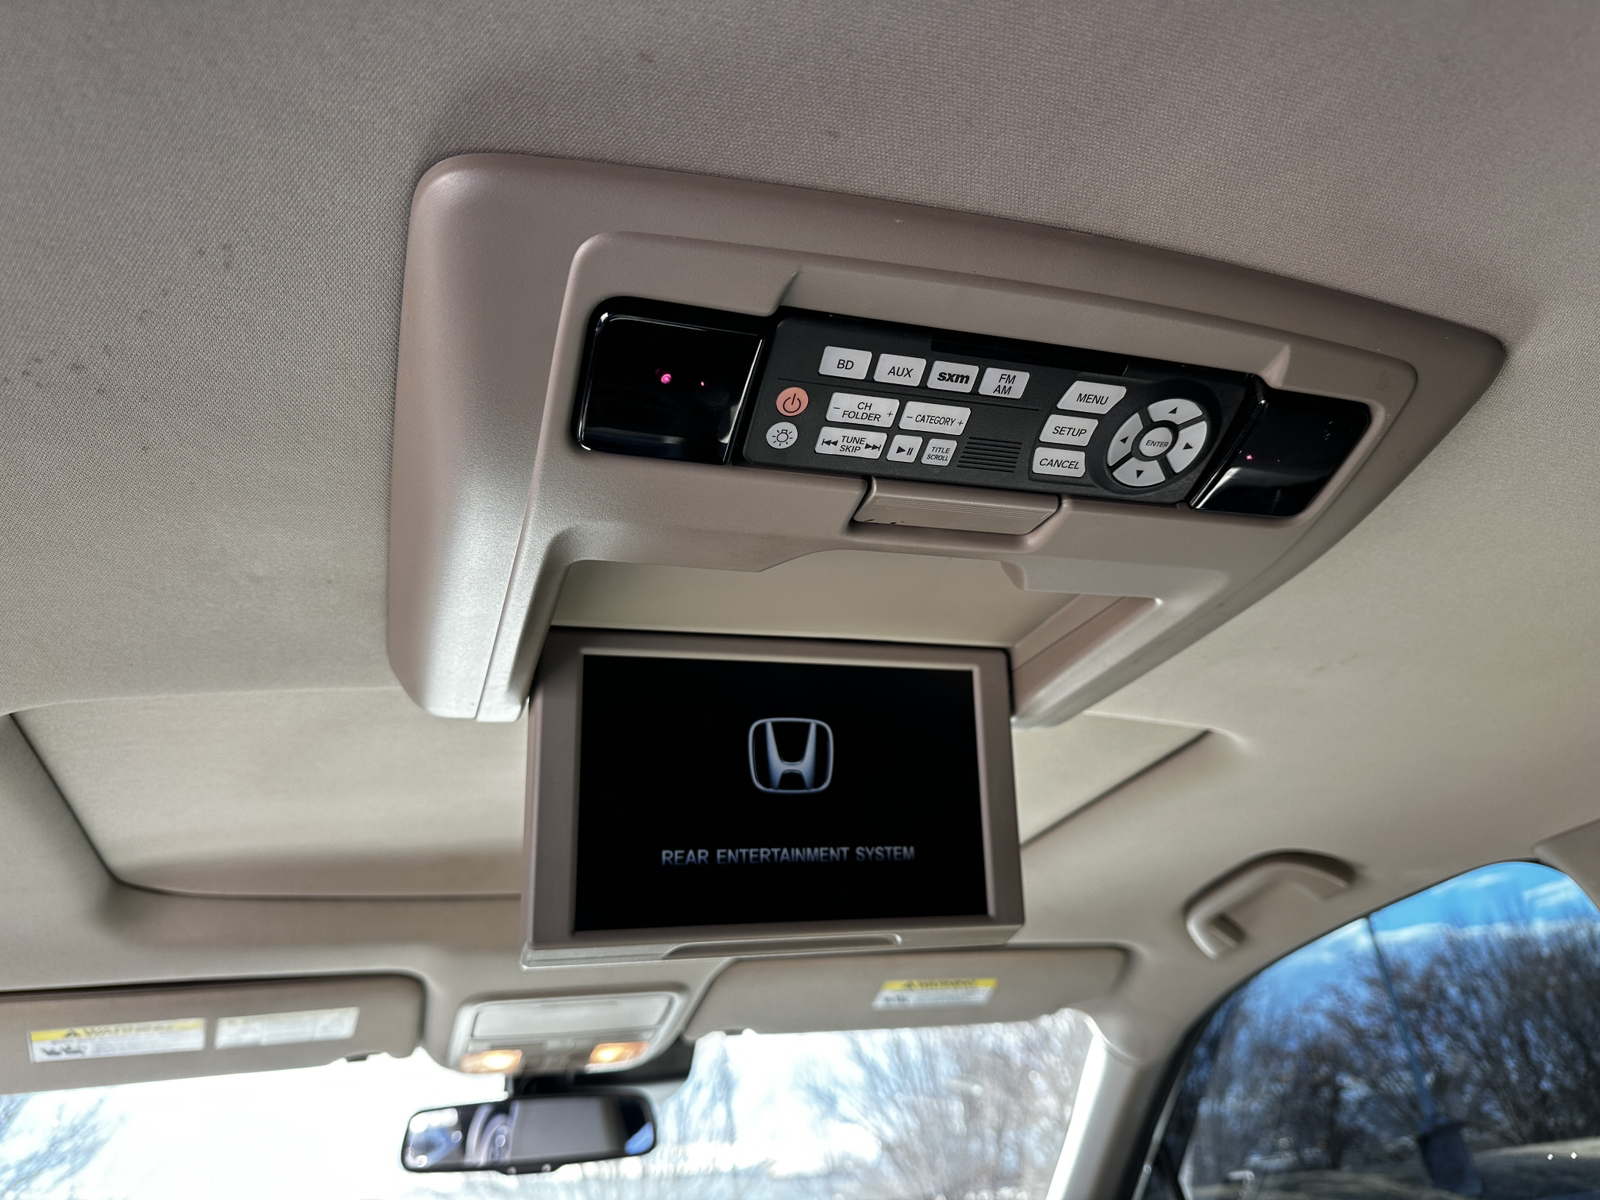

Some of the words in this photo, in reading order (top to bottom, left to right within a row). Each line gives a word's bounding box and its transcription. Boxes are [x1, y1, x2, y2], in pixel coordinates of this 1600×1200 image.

[836, 358, 855, 371] BD
[887, 366, 914, 379] AUX
[936, 370, 970, 385] sxm
[998, 374, 1016, 384] FM
[992, 385, 1011, 395] AM
[1076, 393, 1109, 405] MENU
[857, 401, 873, 411] CH
[841, 410, 882, 423] FOLDER
[914, 413, 957, 427] CATEGORY
[1051, 425, 1088, 438] SETUP
[841, 435, 867, 446] TUNE
[1145, 439, 1170, 449] ENTER
[839, 444, 861, 454] SKIP
[931, 446, 951, 454] TITLE
[926, 453, 950, 462] SCROLL
[1038, 457, 1080, 470] CANCEL
[661, 849, 709, 866] REAR
[716, 847, 850, 865] ENTERTAINMENT
[855, 846, 916, 862] SYSTEM
